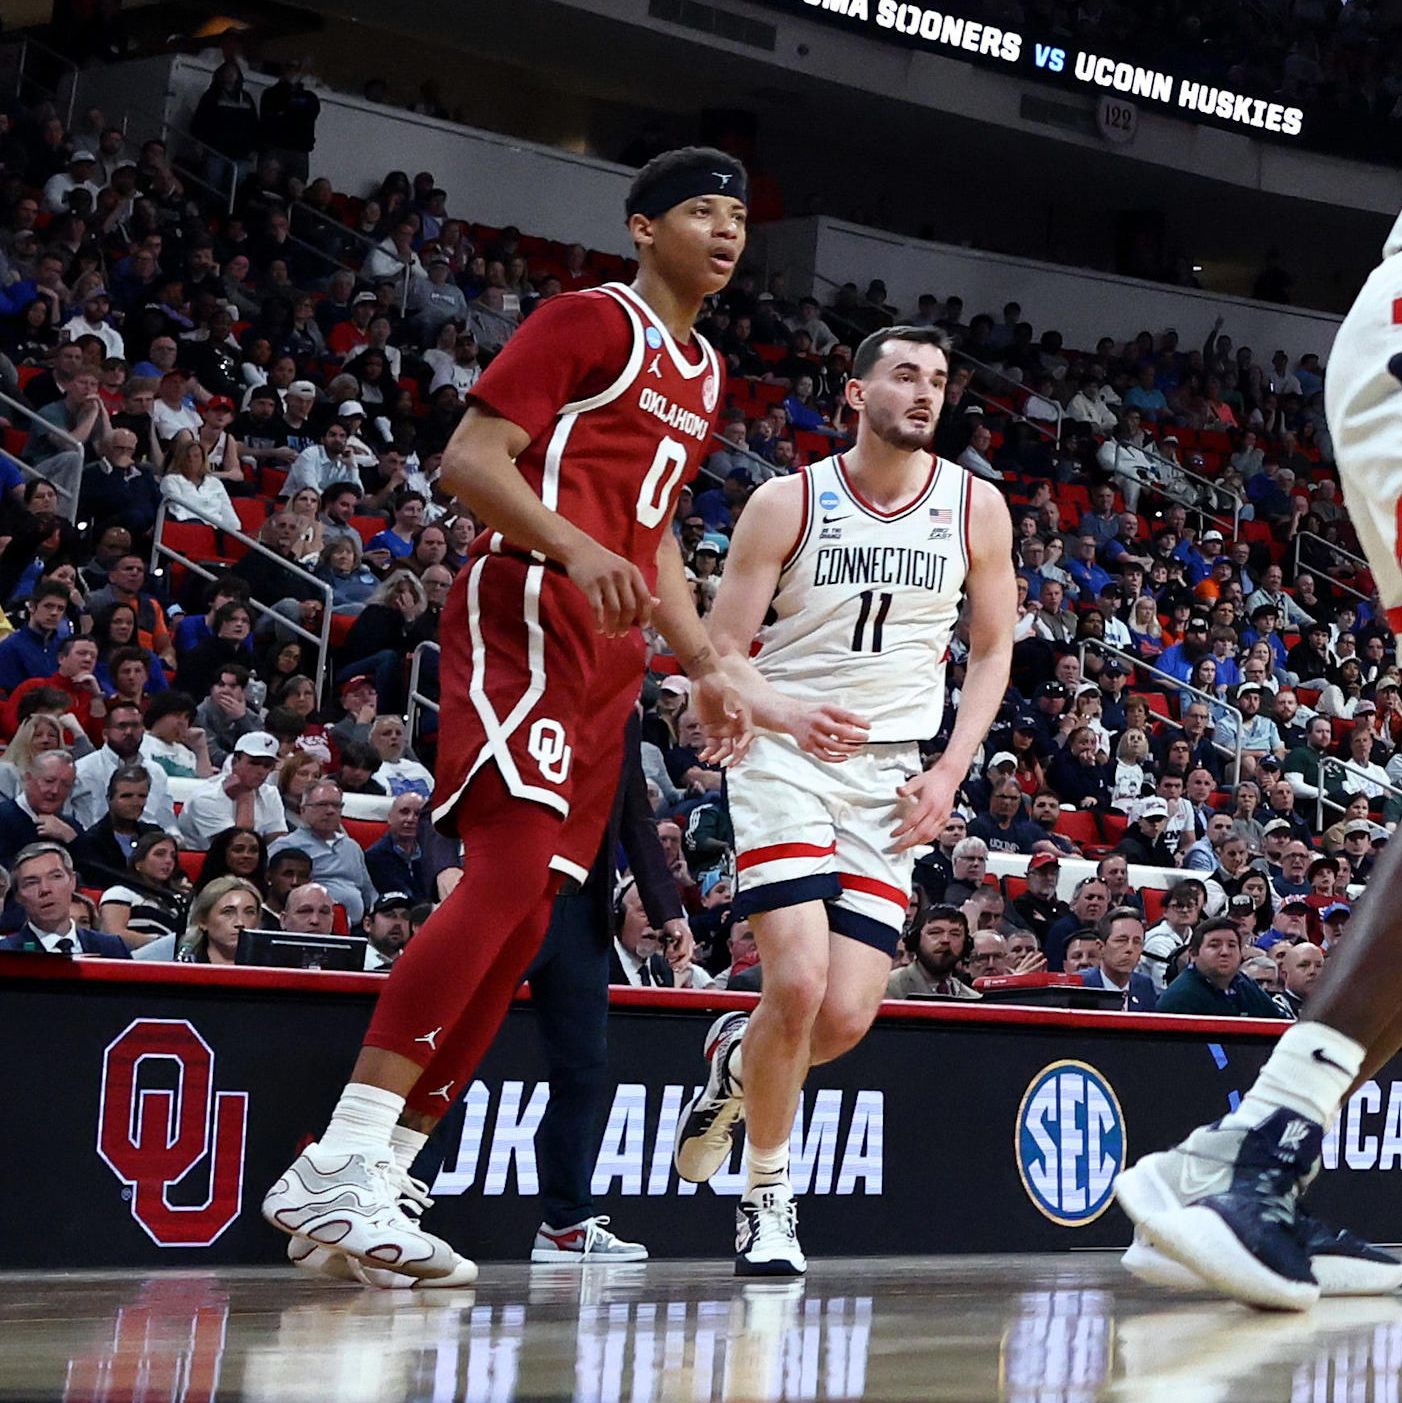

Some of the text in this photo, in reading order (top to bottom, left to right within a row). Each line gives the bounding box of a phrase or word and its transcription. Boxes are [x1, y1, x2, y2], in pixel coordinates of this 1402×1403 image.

[1033, 42, 1068, 74] VS
[1074, 51, 1175, 104] UCONN
[1178, 80, 1304, 137] HUSKIES
[1104, 105, 1133, 133] 122
[639, 388, 709, 441] OKLAHOM
[635, 435, 689, 530] 0
[814, 547, 948, 593] CONNECTICUT
[851, 590, 893, 653] 11
[528, 717, 571, 785] OU
[97, 1017, 249, 1247] OU
[1021, 1072, 1122, 1215] SEC
